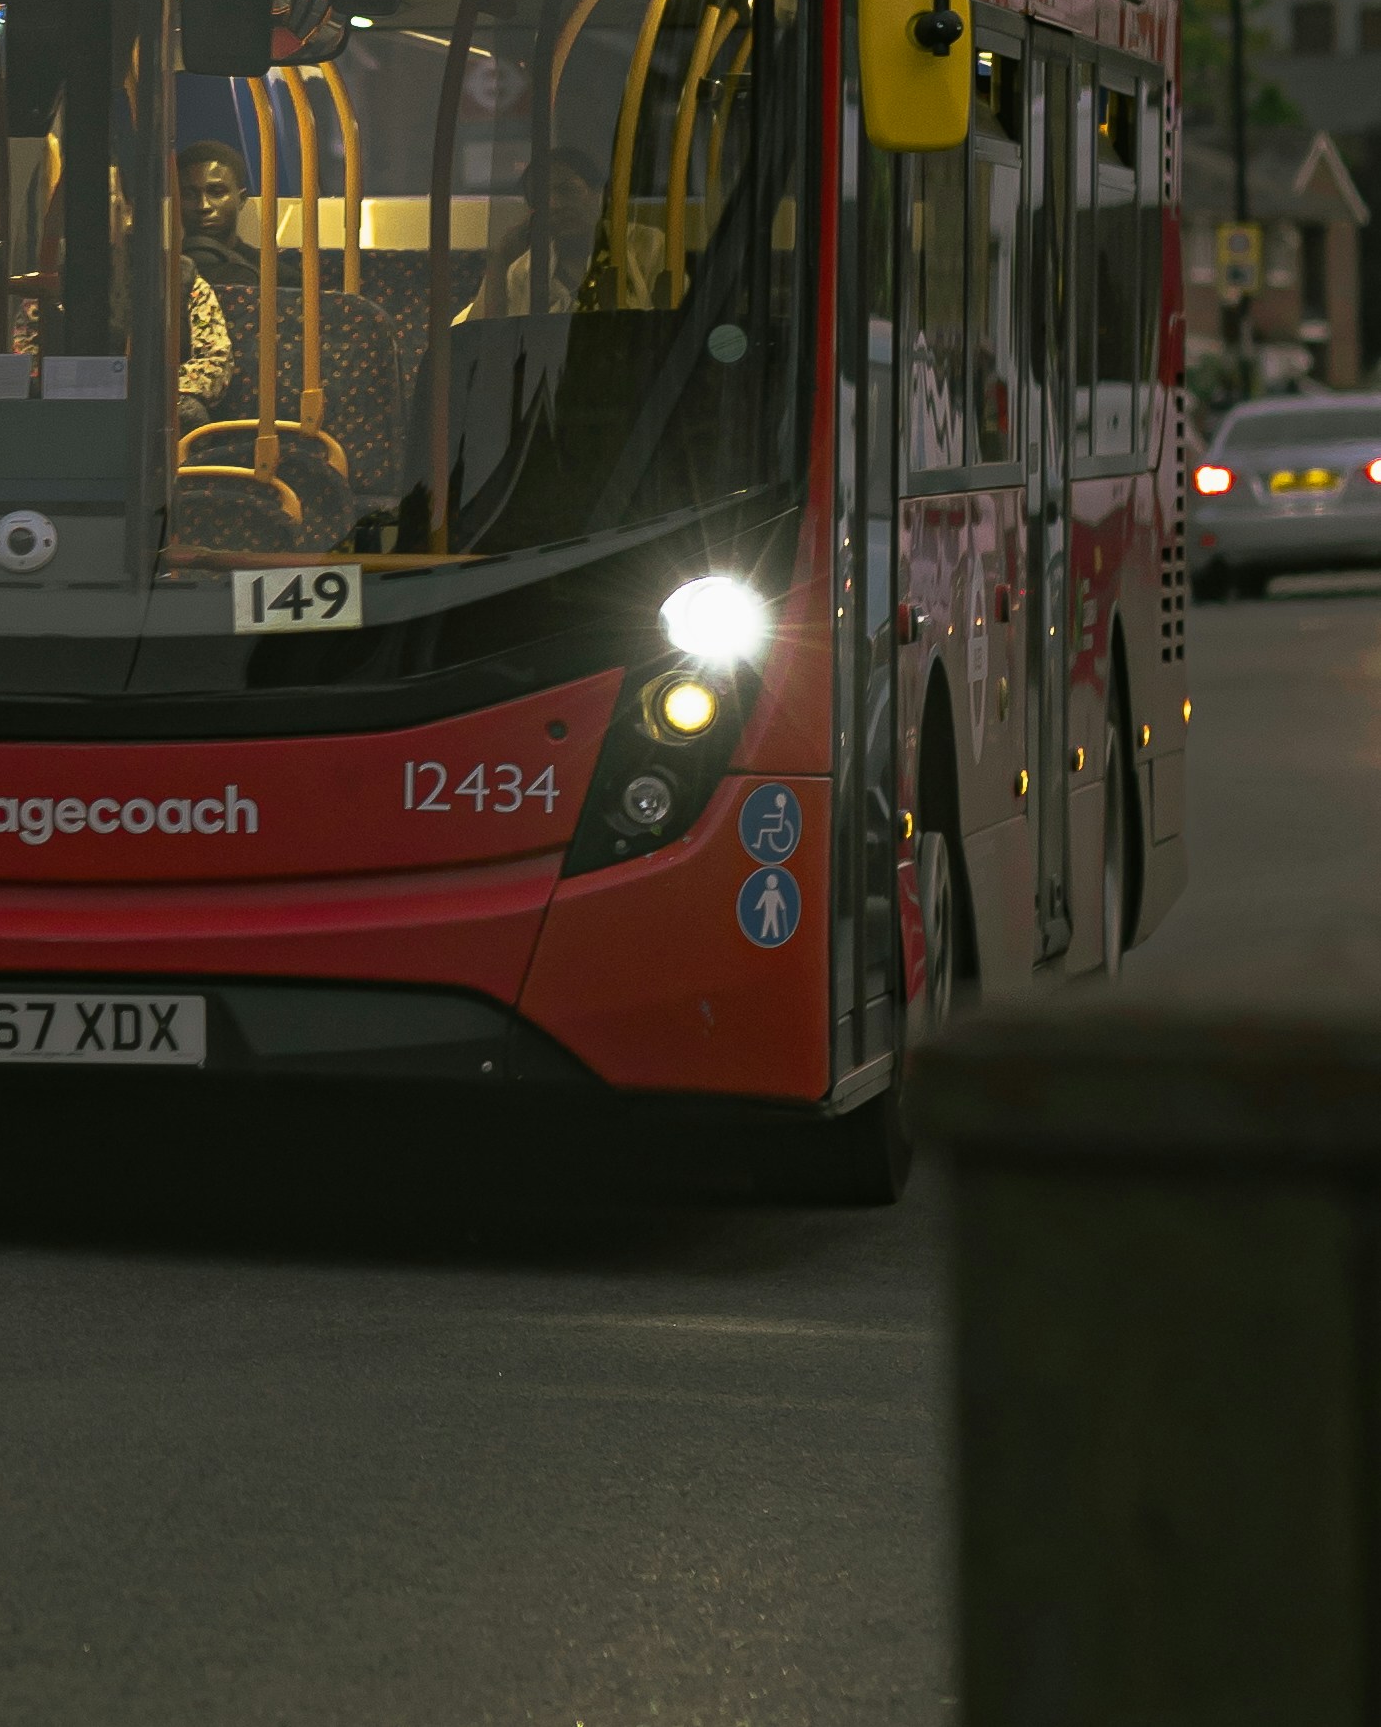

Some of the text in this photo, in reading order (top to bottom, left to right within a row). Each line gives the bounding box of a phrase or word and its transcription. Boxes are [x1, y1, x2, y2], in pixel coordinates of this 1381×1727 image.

[251, 571, 351, 624] 149
[403, 760, 561, 815] 12434
[75, 1002, 180, 1052] XDX
